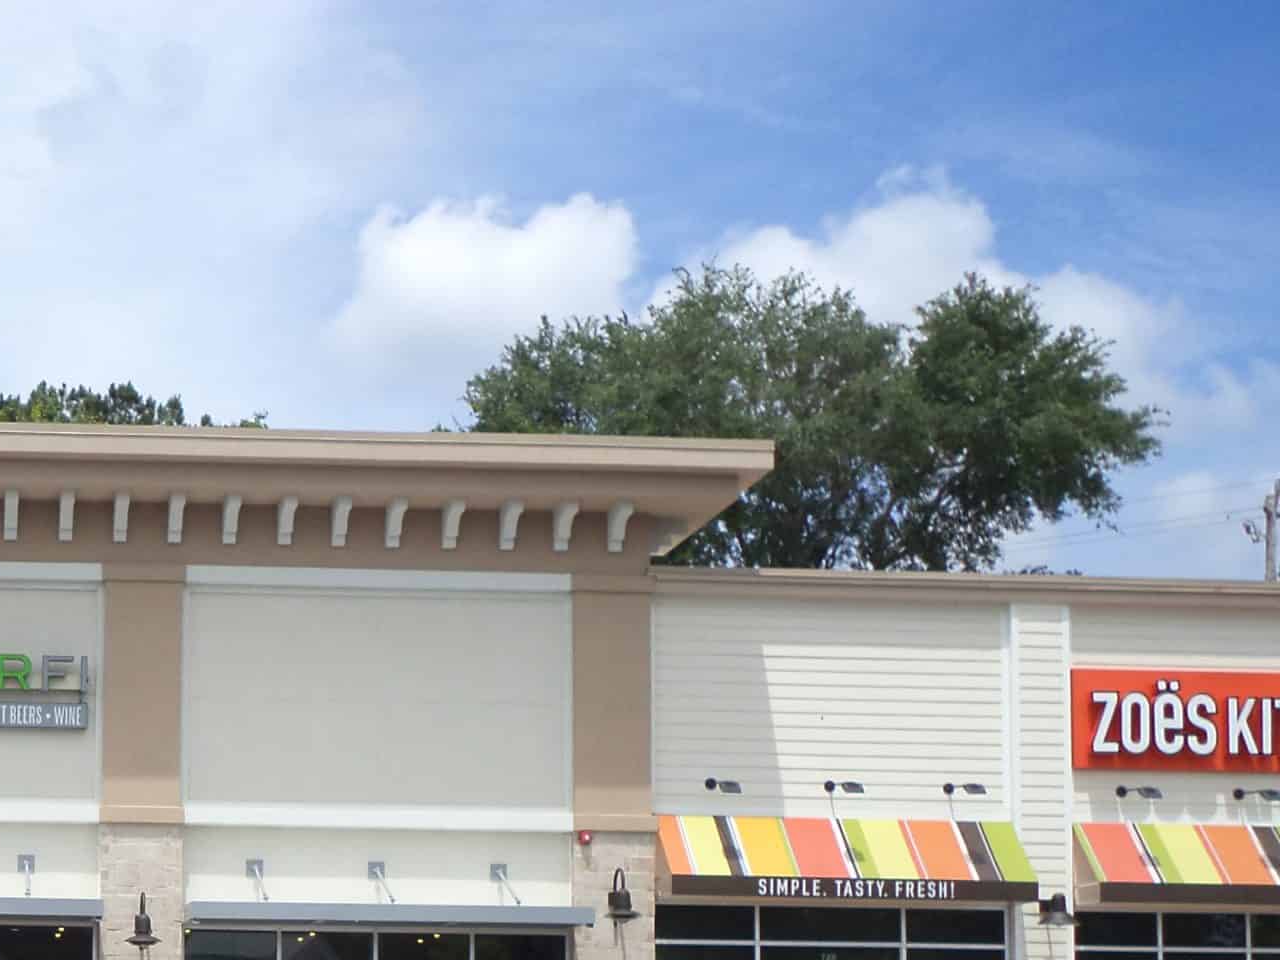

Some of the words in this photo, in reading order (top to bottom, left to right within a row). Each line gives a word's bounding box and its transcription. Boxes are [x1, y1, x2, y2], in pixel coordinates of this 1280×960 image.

[9, 705, 43, 725] BEERS
[53, 706, 83, 727] WINE
[1227, 697, 1280, 755] KI
[757, 878, 827, 897] SIMPLE.
[834, 879, 889, 899] TASTY.
[894, 880, 956, 900] FRESH!
